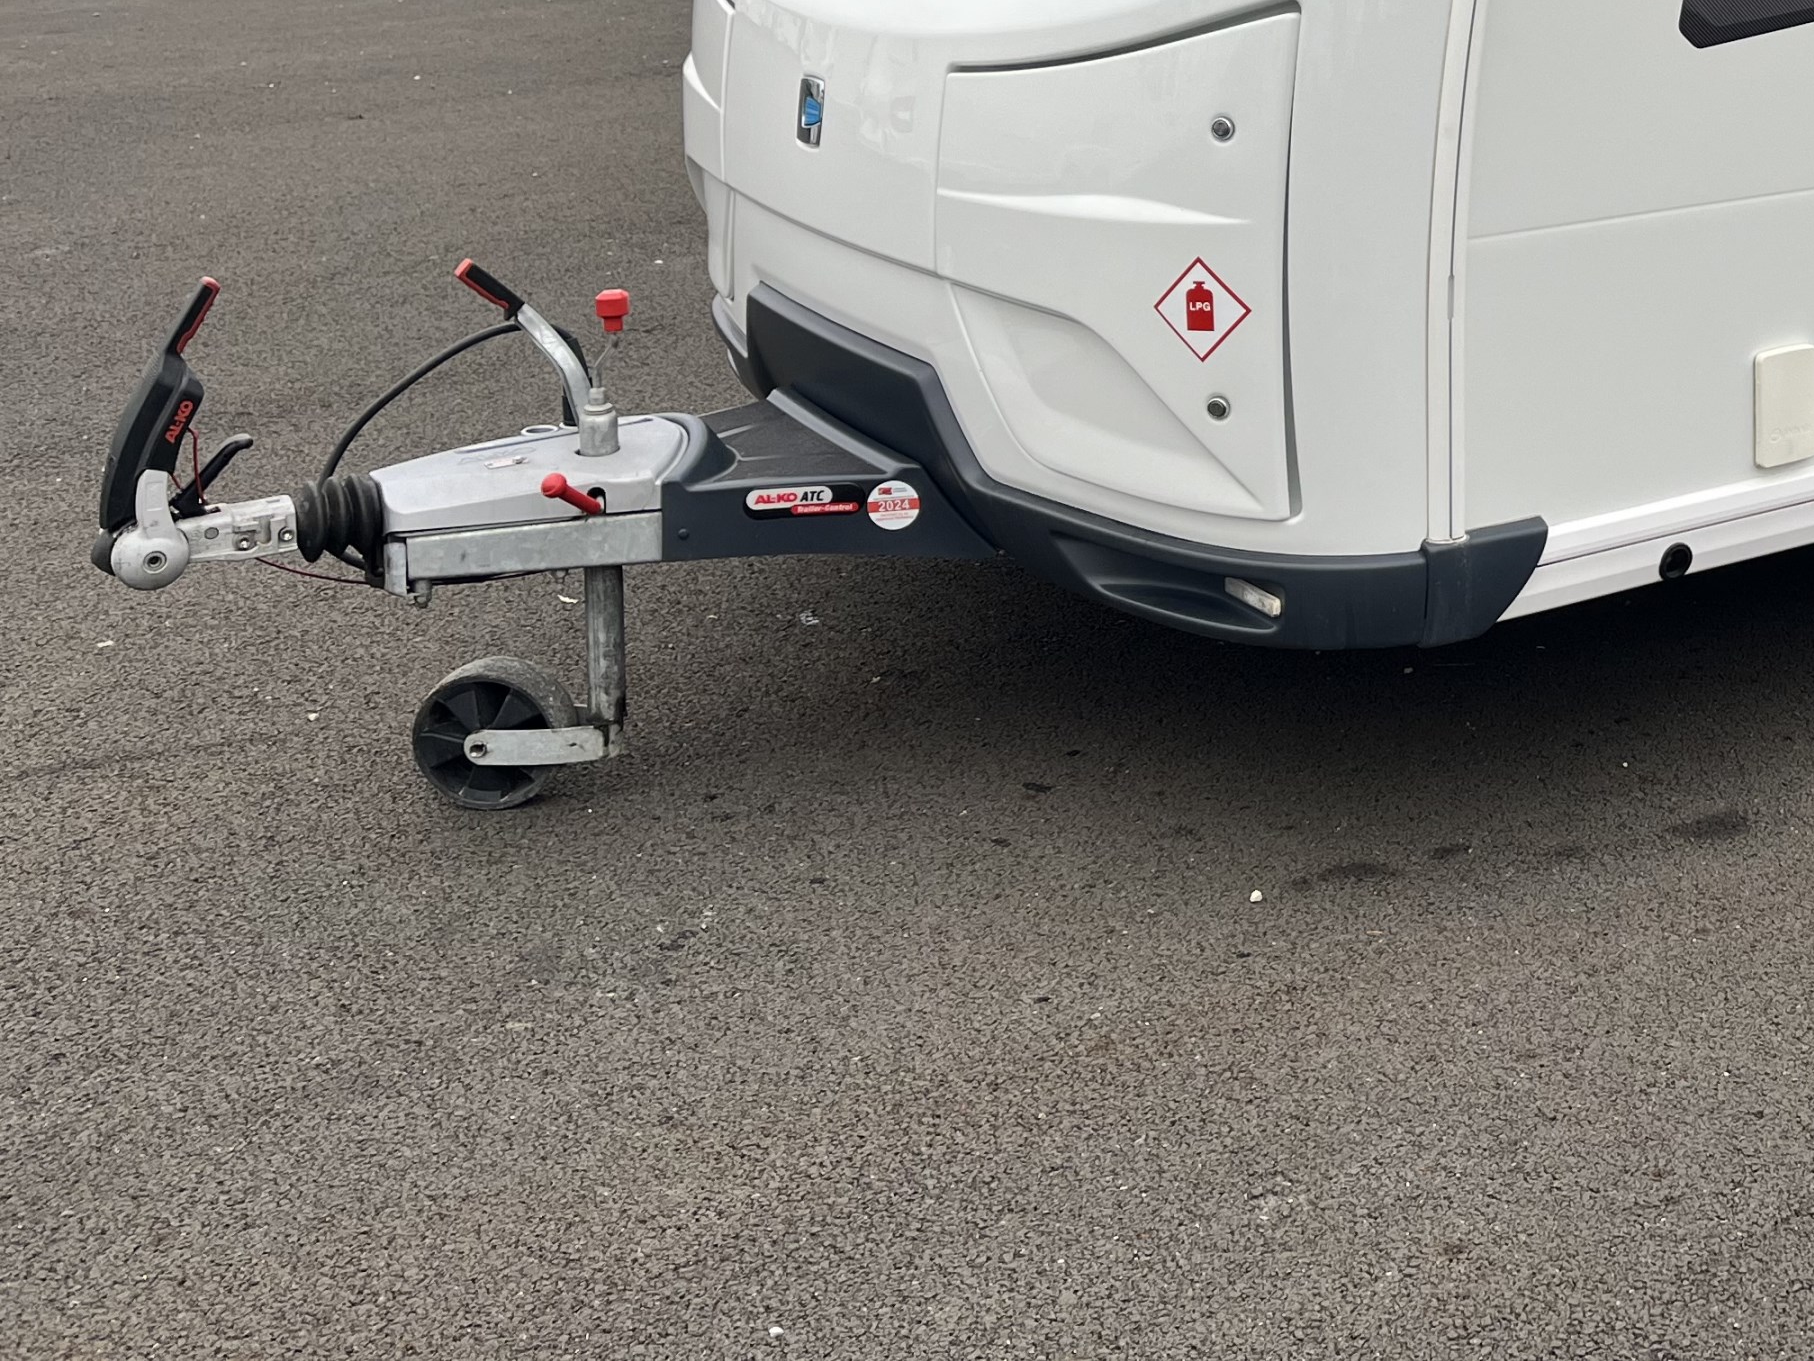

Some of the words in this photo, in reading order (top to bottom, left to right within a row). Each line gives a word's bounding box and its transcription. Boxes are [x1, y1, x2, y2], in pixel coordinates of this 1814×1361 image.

[1189, 302, 1211, 311] LPG
[165, 400, 193, 443] AL-KO
[754, 492, 798, 505] AL-KO
[800, 490, 824, 502] ATC
[878, 499, 909, 512] 2024
